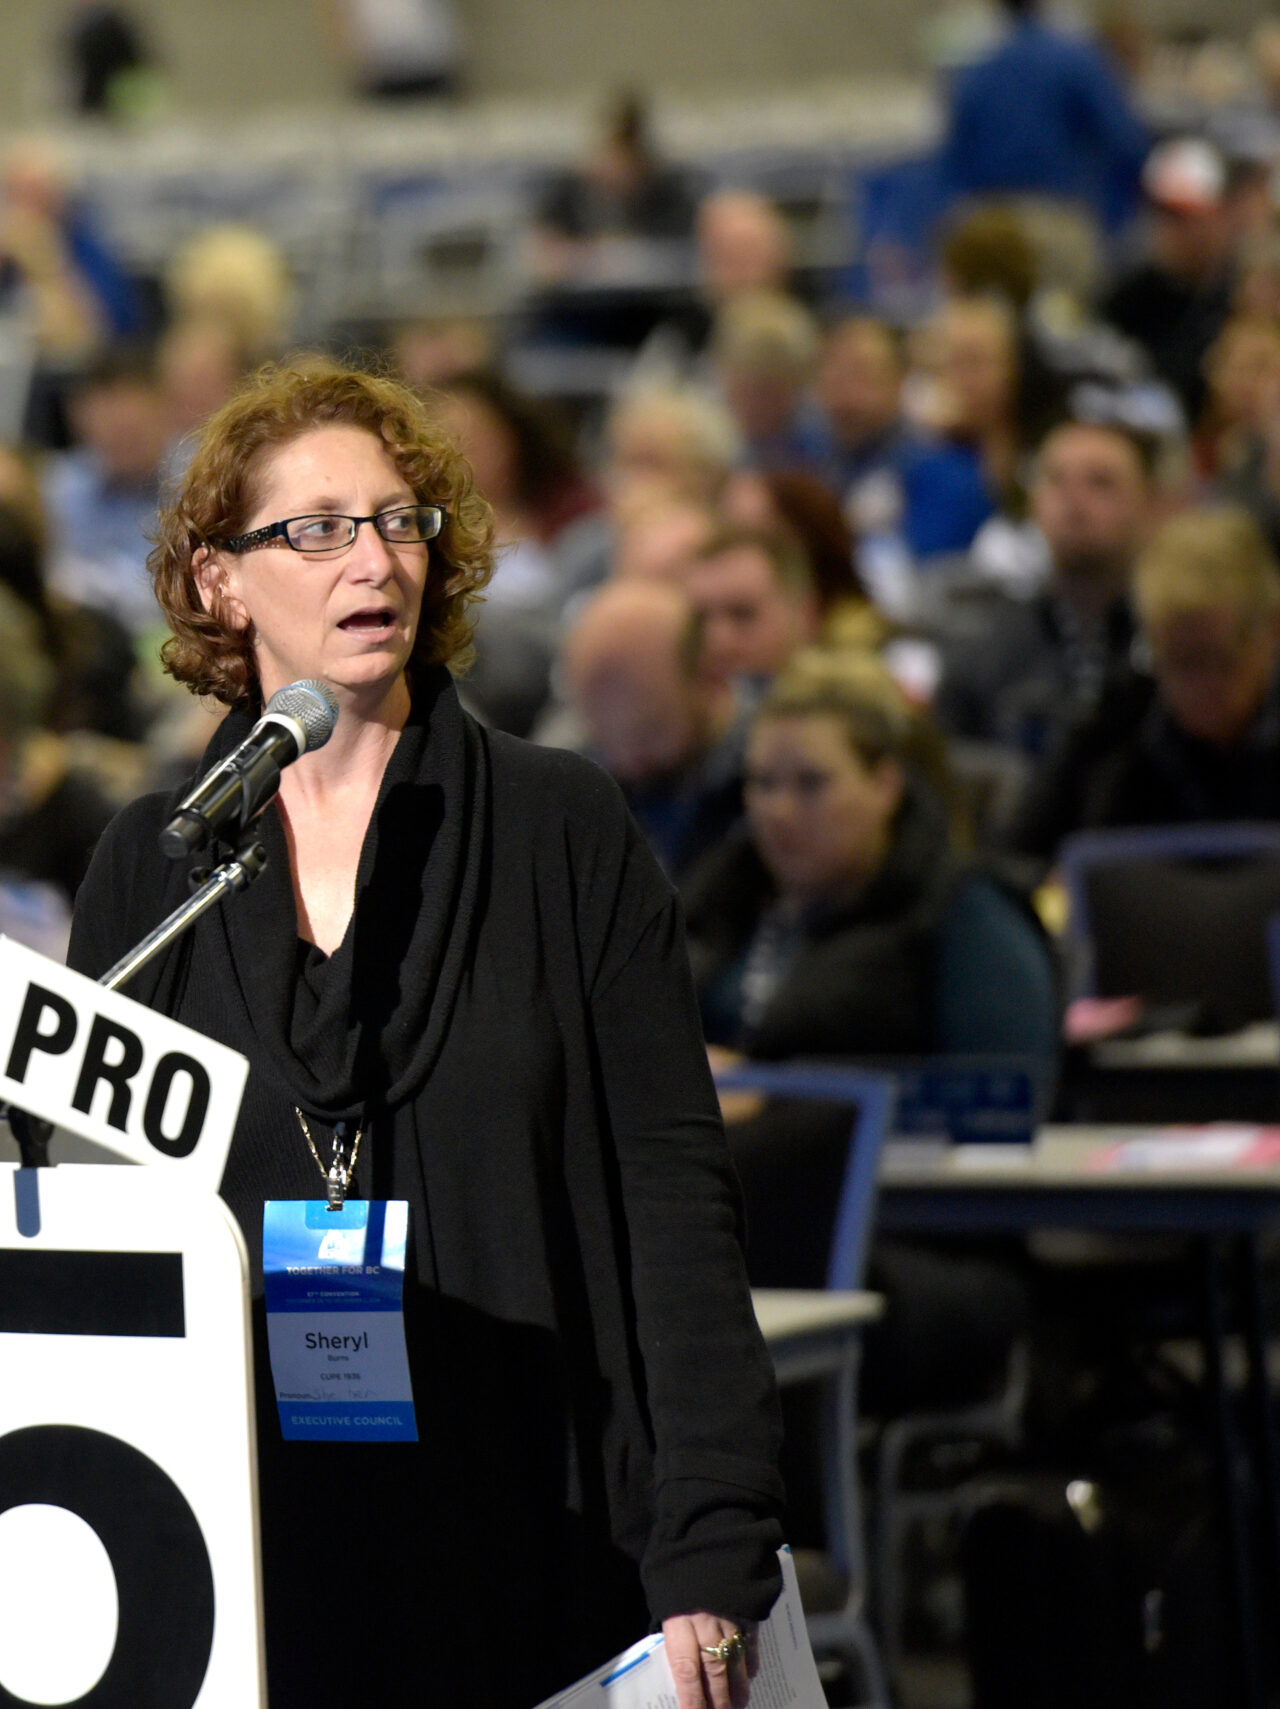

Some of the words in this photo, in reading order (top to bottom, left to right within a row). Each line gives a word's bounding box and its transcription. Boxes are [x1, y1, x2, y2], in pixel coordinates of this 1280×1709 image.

[4, 980, 211, 1159] PRO
[286, 1265, 339, 1276] TOGETHER
[342, 1265, 363, 1275] FOR
[365, 1265, 380, 1275] BC
[305, 1331, 369, 1352] Sheryl
[327, 1354, 349, 1362] Burns
[320, 1373, 341, 1381] CUPE
[291, 1415, 351, 1425] EXECUTIVE
[353, 1416, 403, 1426] COUNCIL
